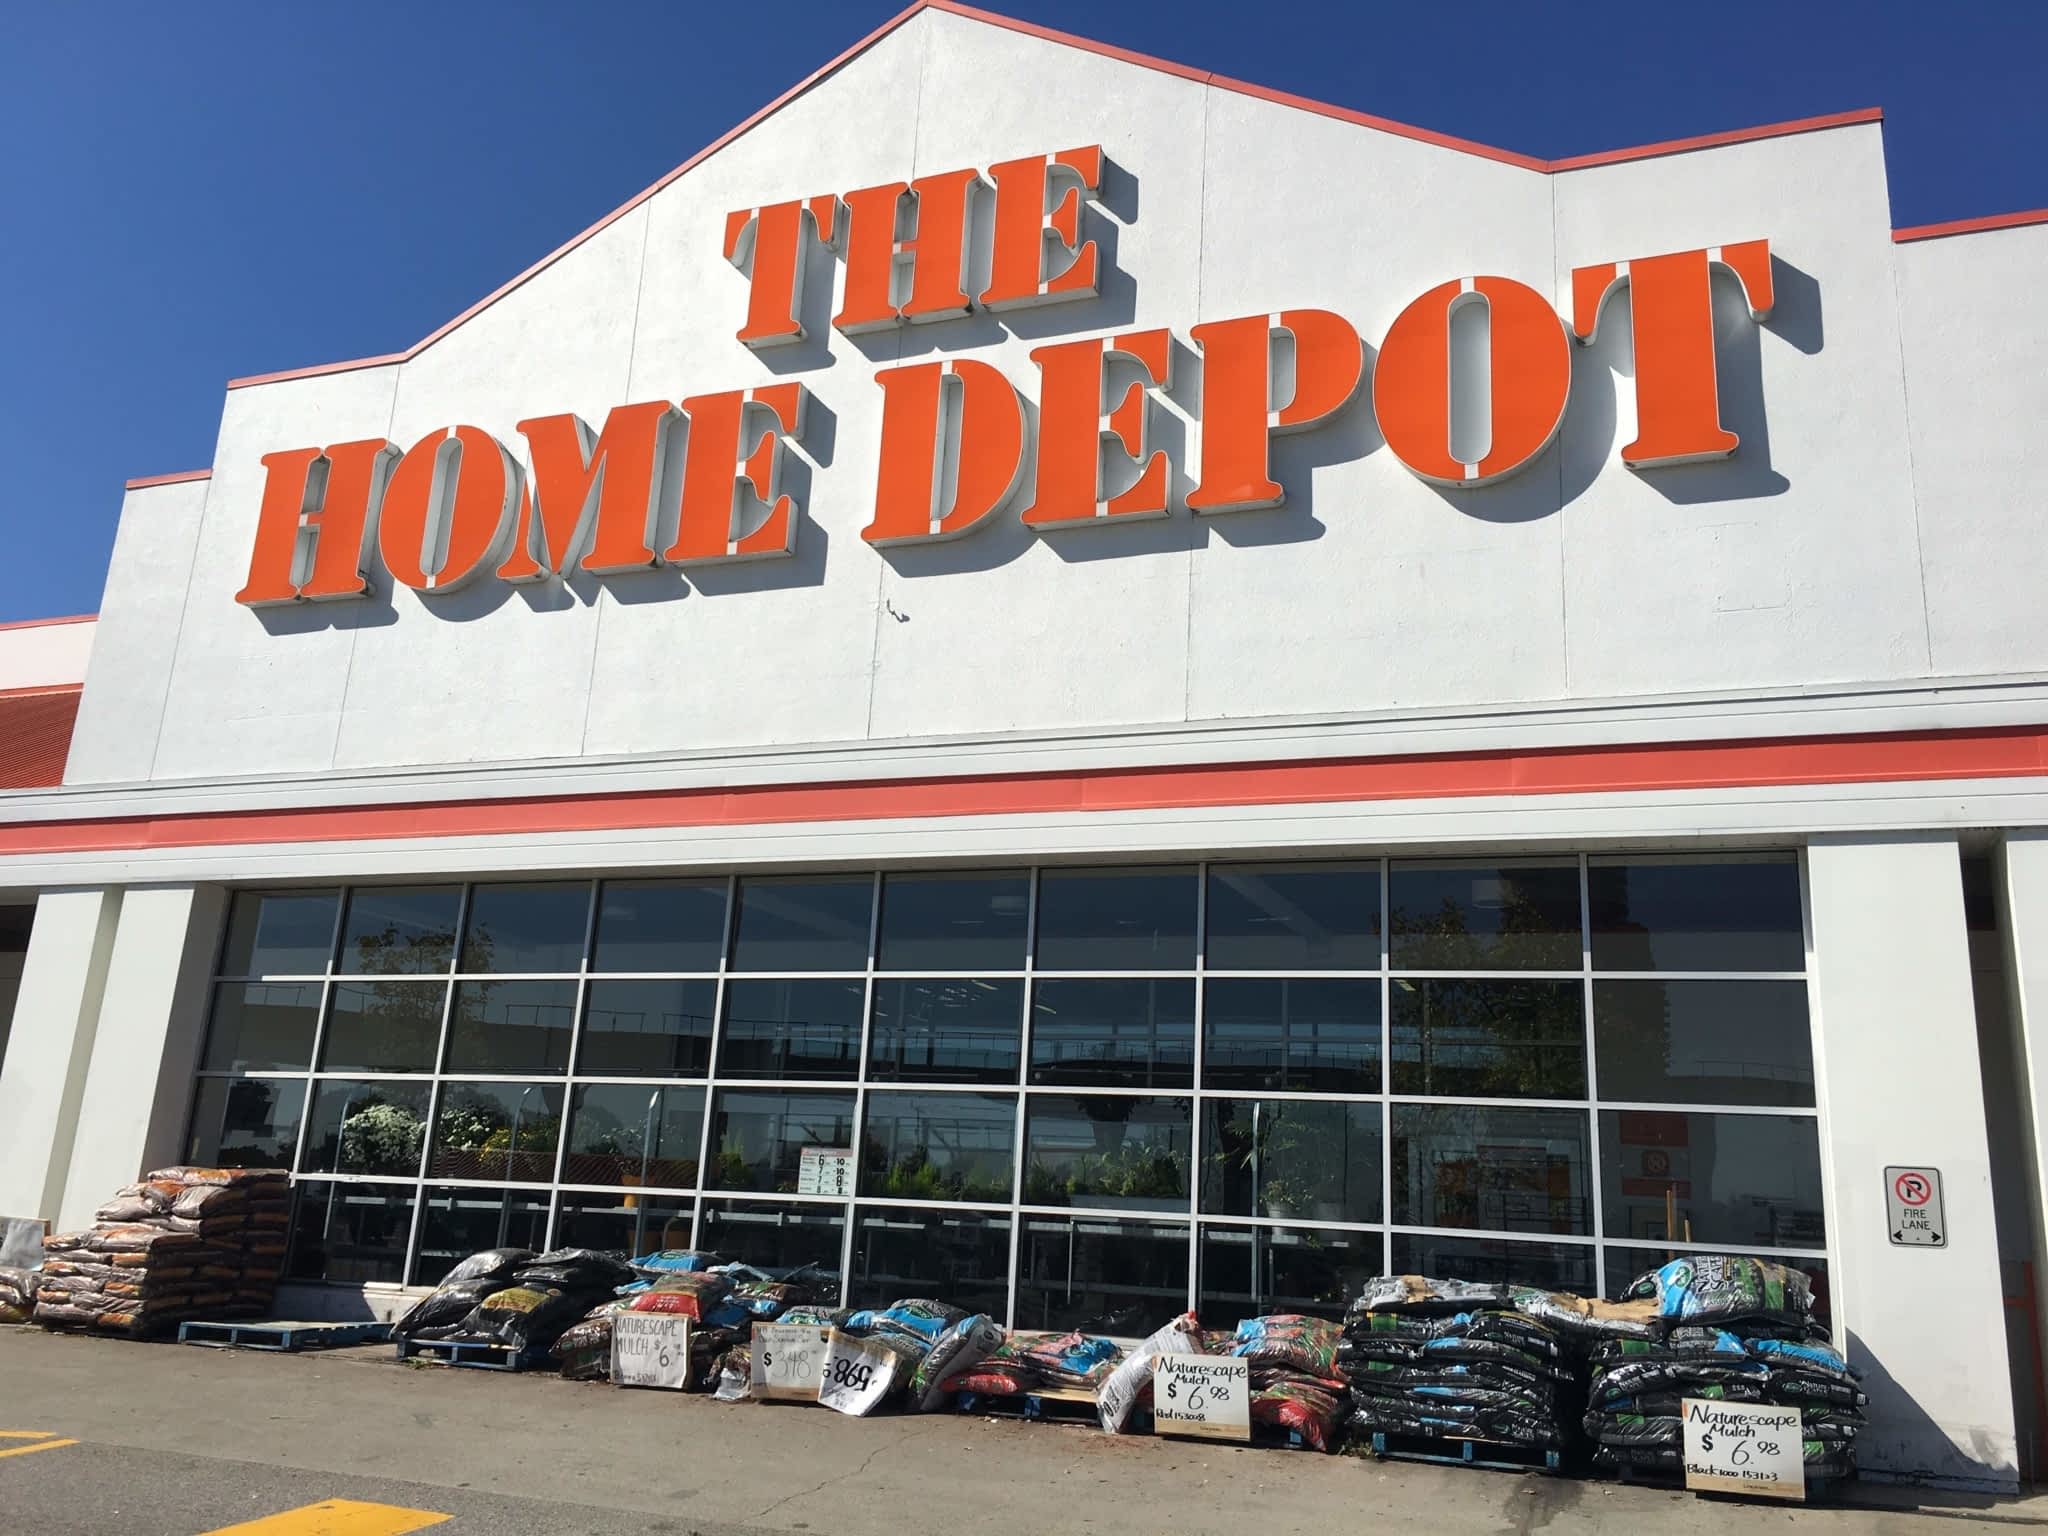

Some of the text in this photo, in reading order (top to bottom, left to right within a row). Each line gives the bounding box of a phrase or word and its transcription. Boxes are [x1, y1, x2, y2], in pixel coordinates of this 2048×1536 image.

[724, 145, 1107, 348] THE
[236, 239, 1777, 608] HOME DEPOT
[1903, 1208, 1927, 1219] FIRE
[1901, 1219, 1932, 1231] LANE
[615, 1317, 679, 1337] NATURESCAPE
[615, 1337, 649, 1356] MULCH
[763, 1351, 772, 1367] $
[1158, 1356, 1248, 1382] Naturescape
[1173, 1373, 1211, 1386] Mulch
[1167, 1382, 1177, 1399] $
[1689, 1404, 1799, 1431] Naturescape
[1708, 1424, 1756, 1438] Mulch
[1701, 1433, 1714, 1453] $
